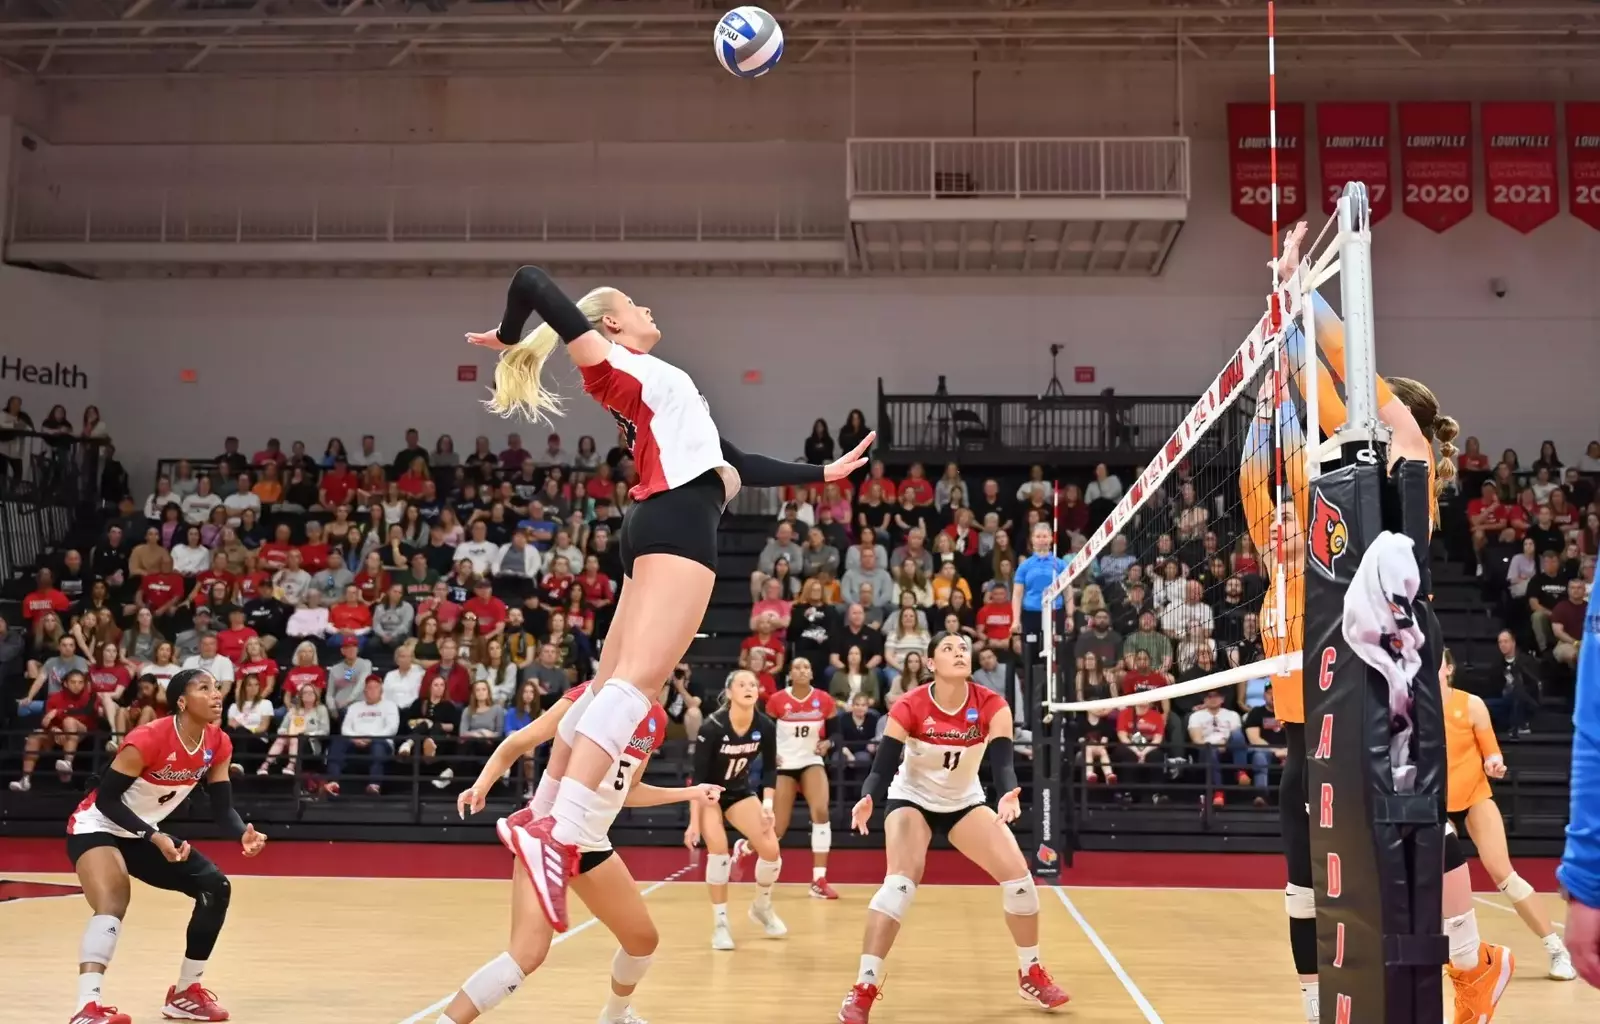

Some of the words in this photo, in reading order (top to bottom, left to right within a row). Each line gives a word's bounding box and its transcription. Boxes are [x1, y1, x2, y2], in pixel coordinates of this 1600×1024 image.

[1326, 136, 1385, 148] LOUISVILLE
[1407, 135, 1466, 148] LOUISVILLE
[1490, 135, 1550, 148] LOUISVILLE
[1328, 185, 1386, 203] 27
[1406, 184, 1469, 204] 2020
[1493, 185, 1551, 204] 2021
[1, 355, 88, 389] Health
[794, 725, 809, 738] 18
[943, 751, 961, 771] 11
[613, 760, 631, 791] 5
